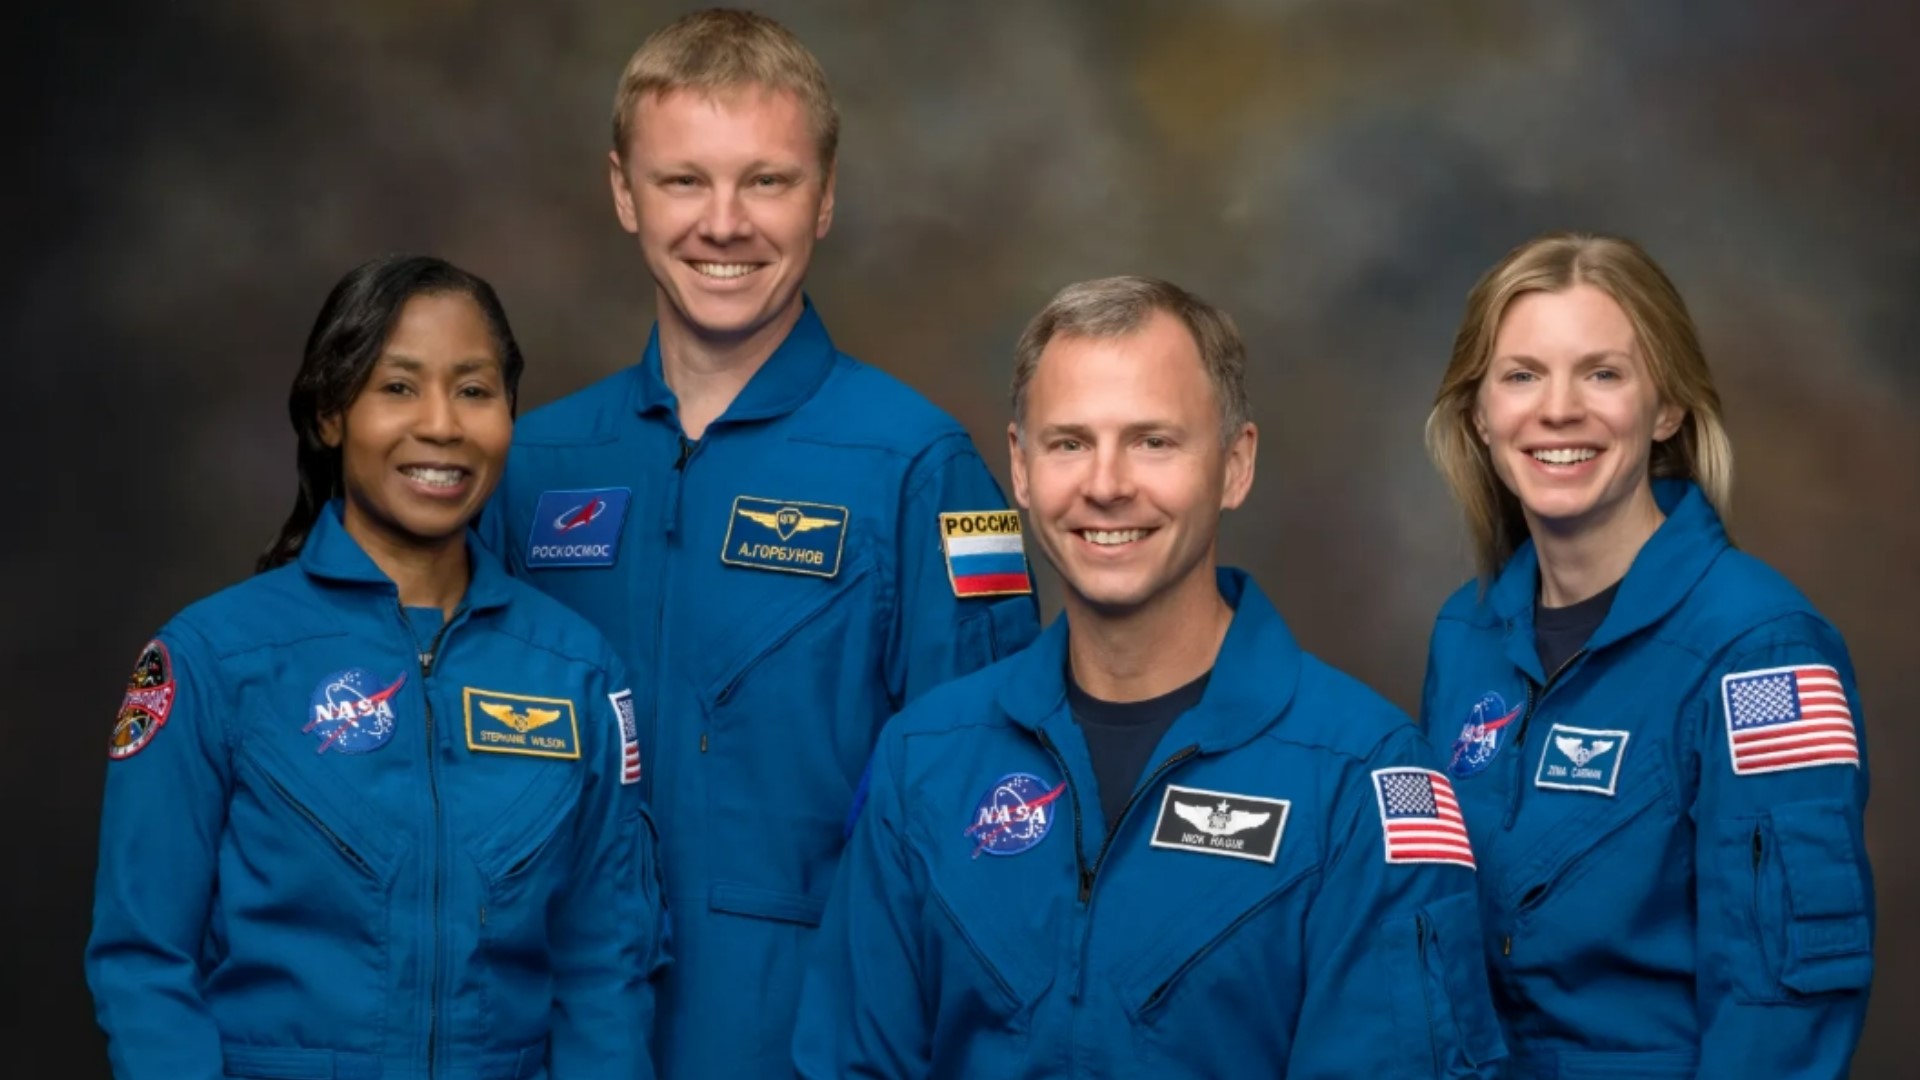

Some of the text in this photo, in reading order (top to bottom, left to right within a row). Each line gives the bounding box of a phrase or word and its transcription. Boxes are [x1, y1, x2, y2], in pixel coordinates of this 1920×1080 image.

[945, 514, 1020, 535] РОССИЯ
[531, 544, 611, 558] РОСКОСМОС
[738, 541, 825, 565] А.ГОРБУНОВ
[314, 699, 395, 723] NASA
[480, 730, 567, 749] STEPHANIE WILSON
[978, 804, 1047, 826] NASA
[1180, 832, 1206, 845] NICK
